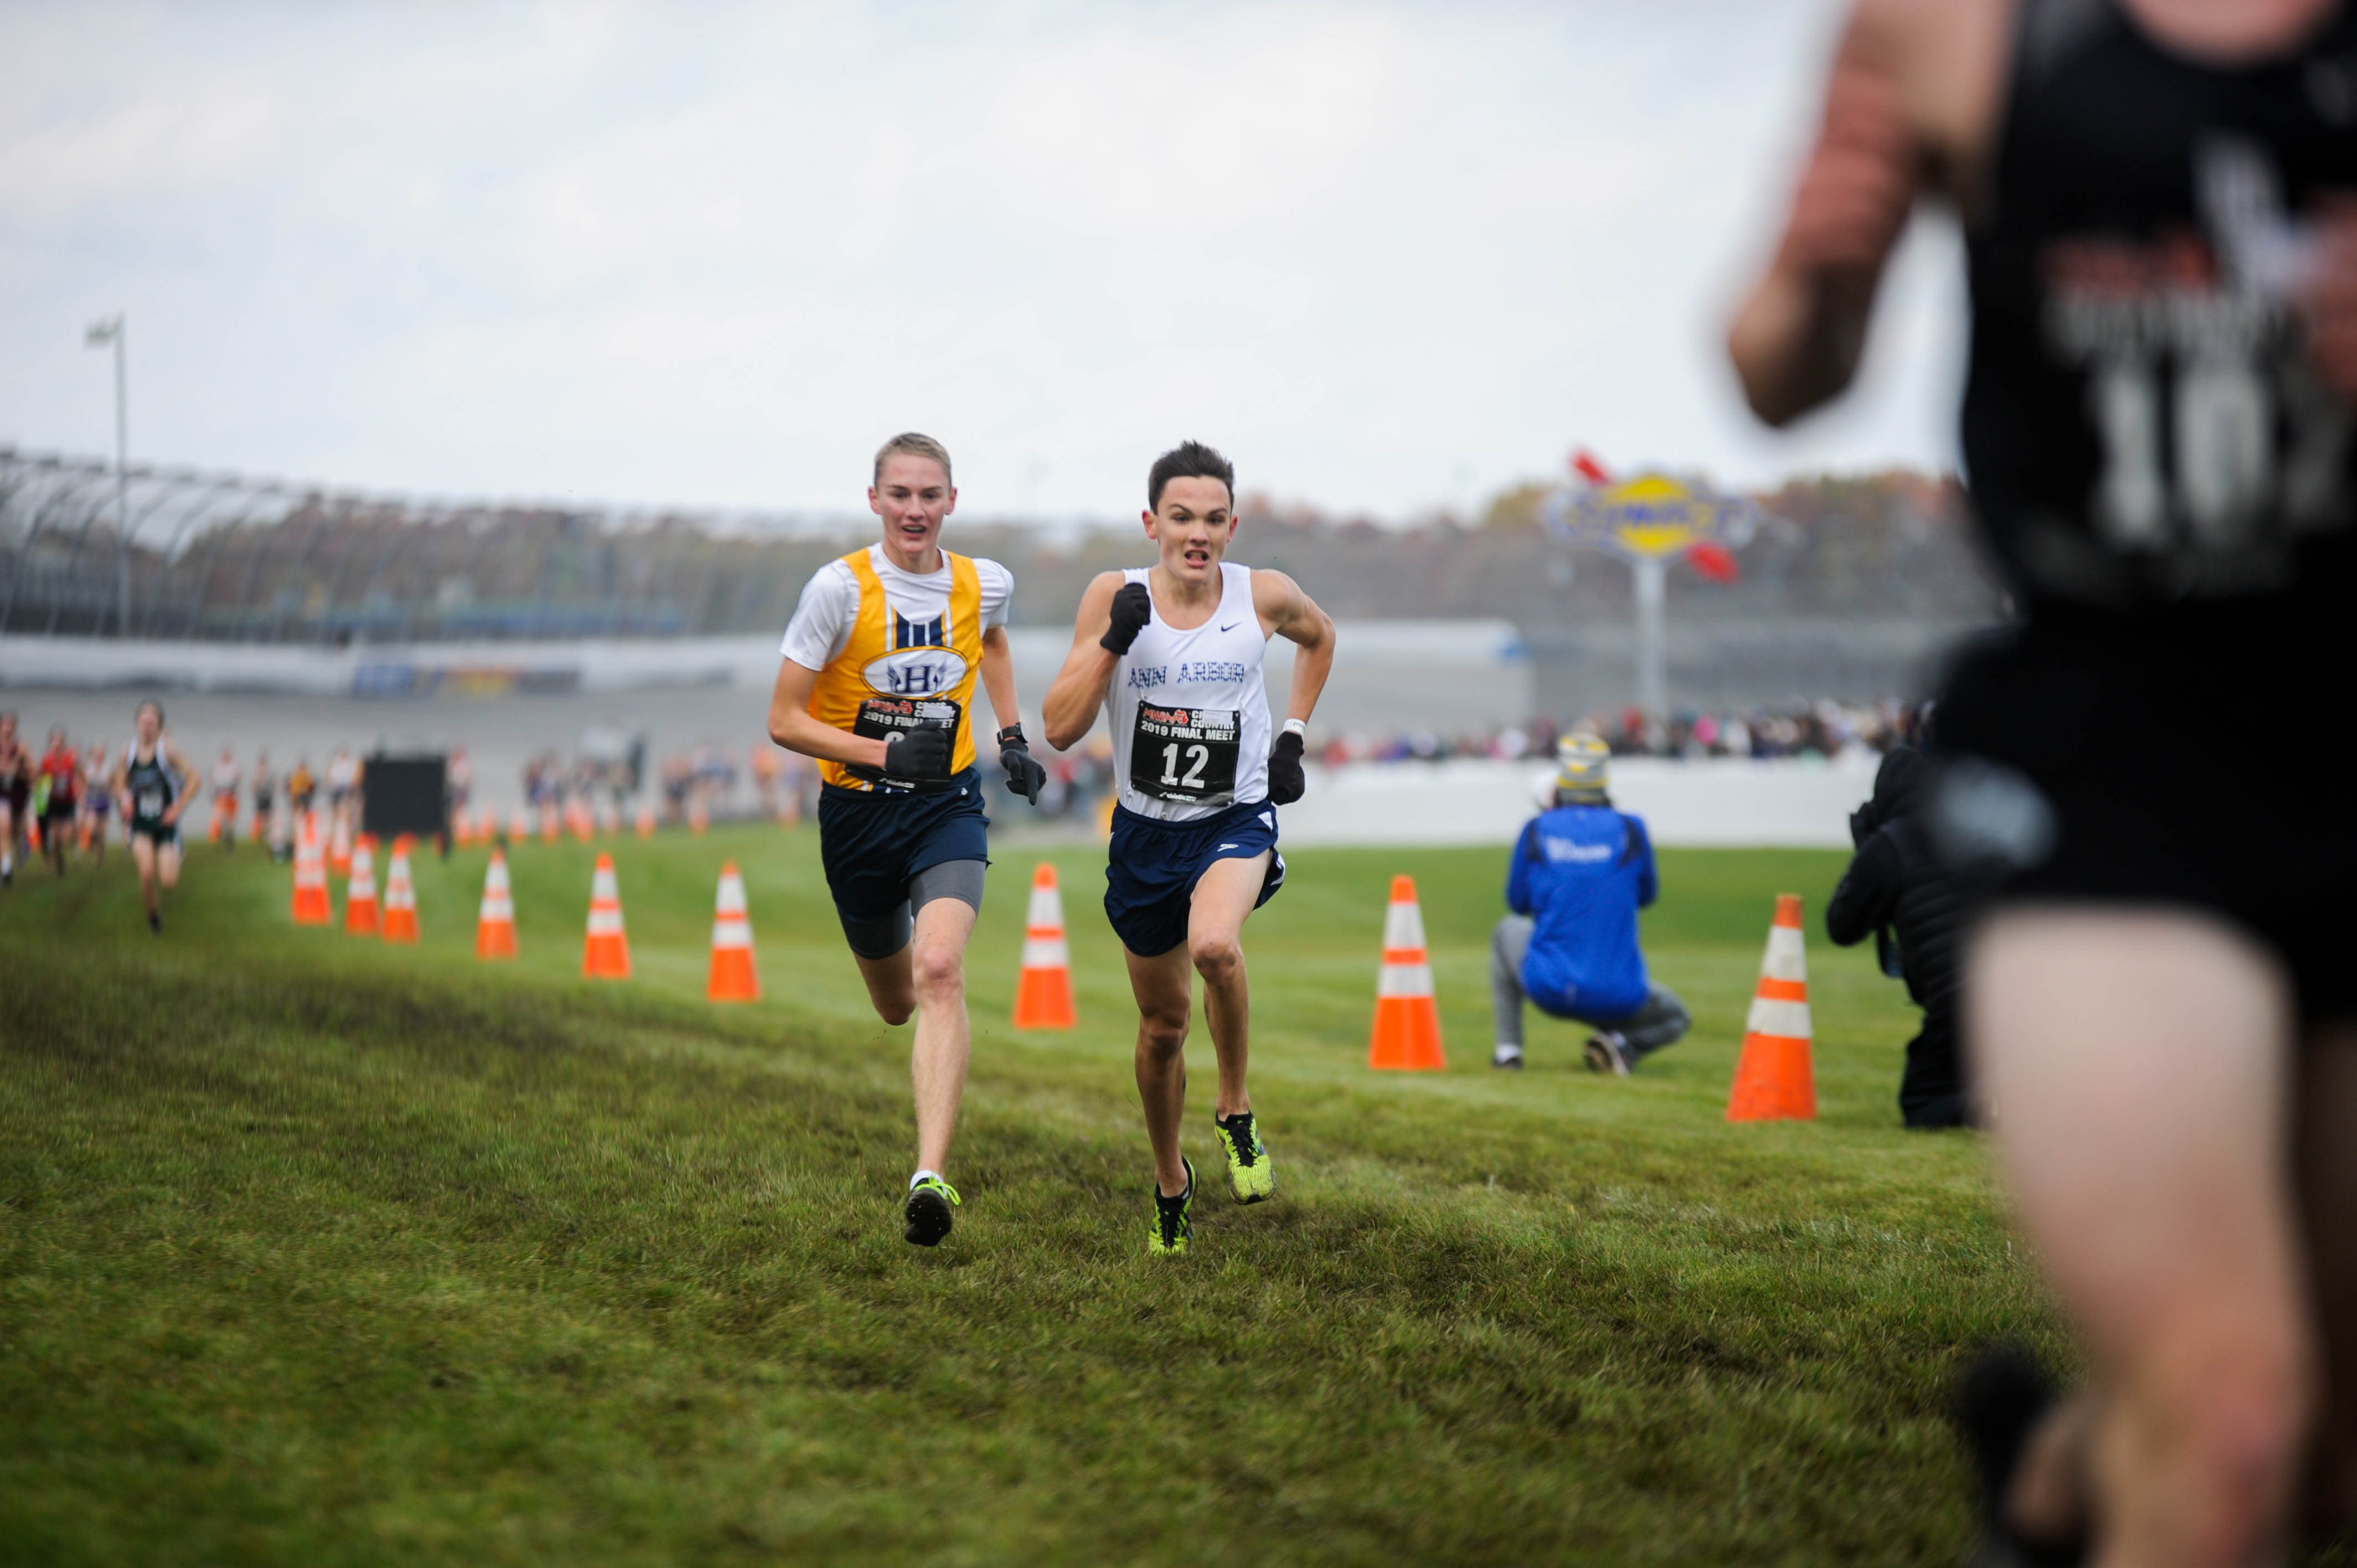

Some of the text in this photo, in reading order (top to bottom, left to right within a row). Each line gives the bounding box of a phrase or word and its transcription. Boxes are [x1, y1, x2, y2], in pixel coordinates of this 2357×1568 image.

[1128, 662, 1244, 689] ANN ARBOR
[863, 711, 892, 725] 2019
[929, 719, 955, 729] ET
[1141, 720, 1235, 741] 2019 FINAL MEET
[1160, 743, 1209, 788] 12
